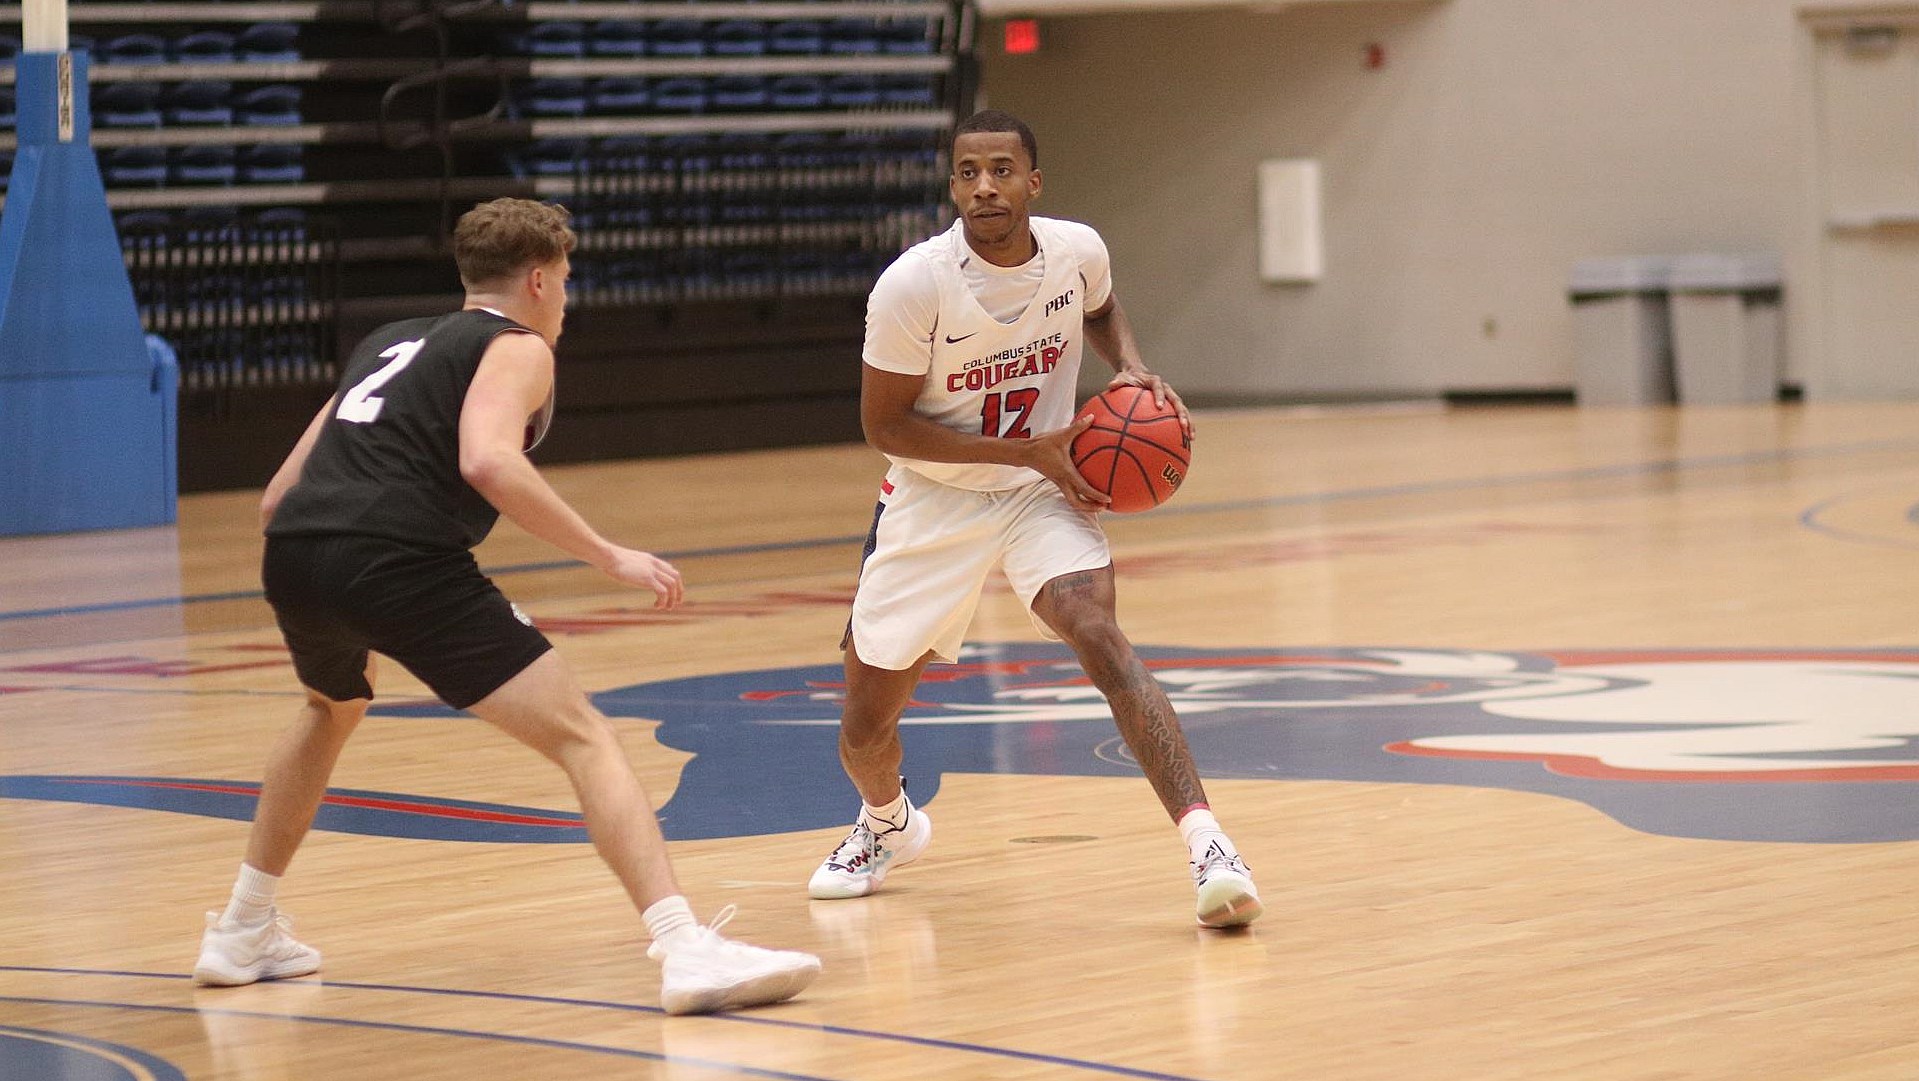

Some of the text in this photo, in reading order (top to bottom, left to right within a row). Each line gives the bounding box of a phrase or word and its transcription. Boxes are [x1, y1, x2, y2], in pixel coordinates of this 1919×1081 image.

[1045, 289, 1074, 318] PBC
[963, 332, 1062, 371] COLUMBUS STATE
[336, 338, 425, 423] 2
[980, 387, 1040, 439] 12
